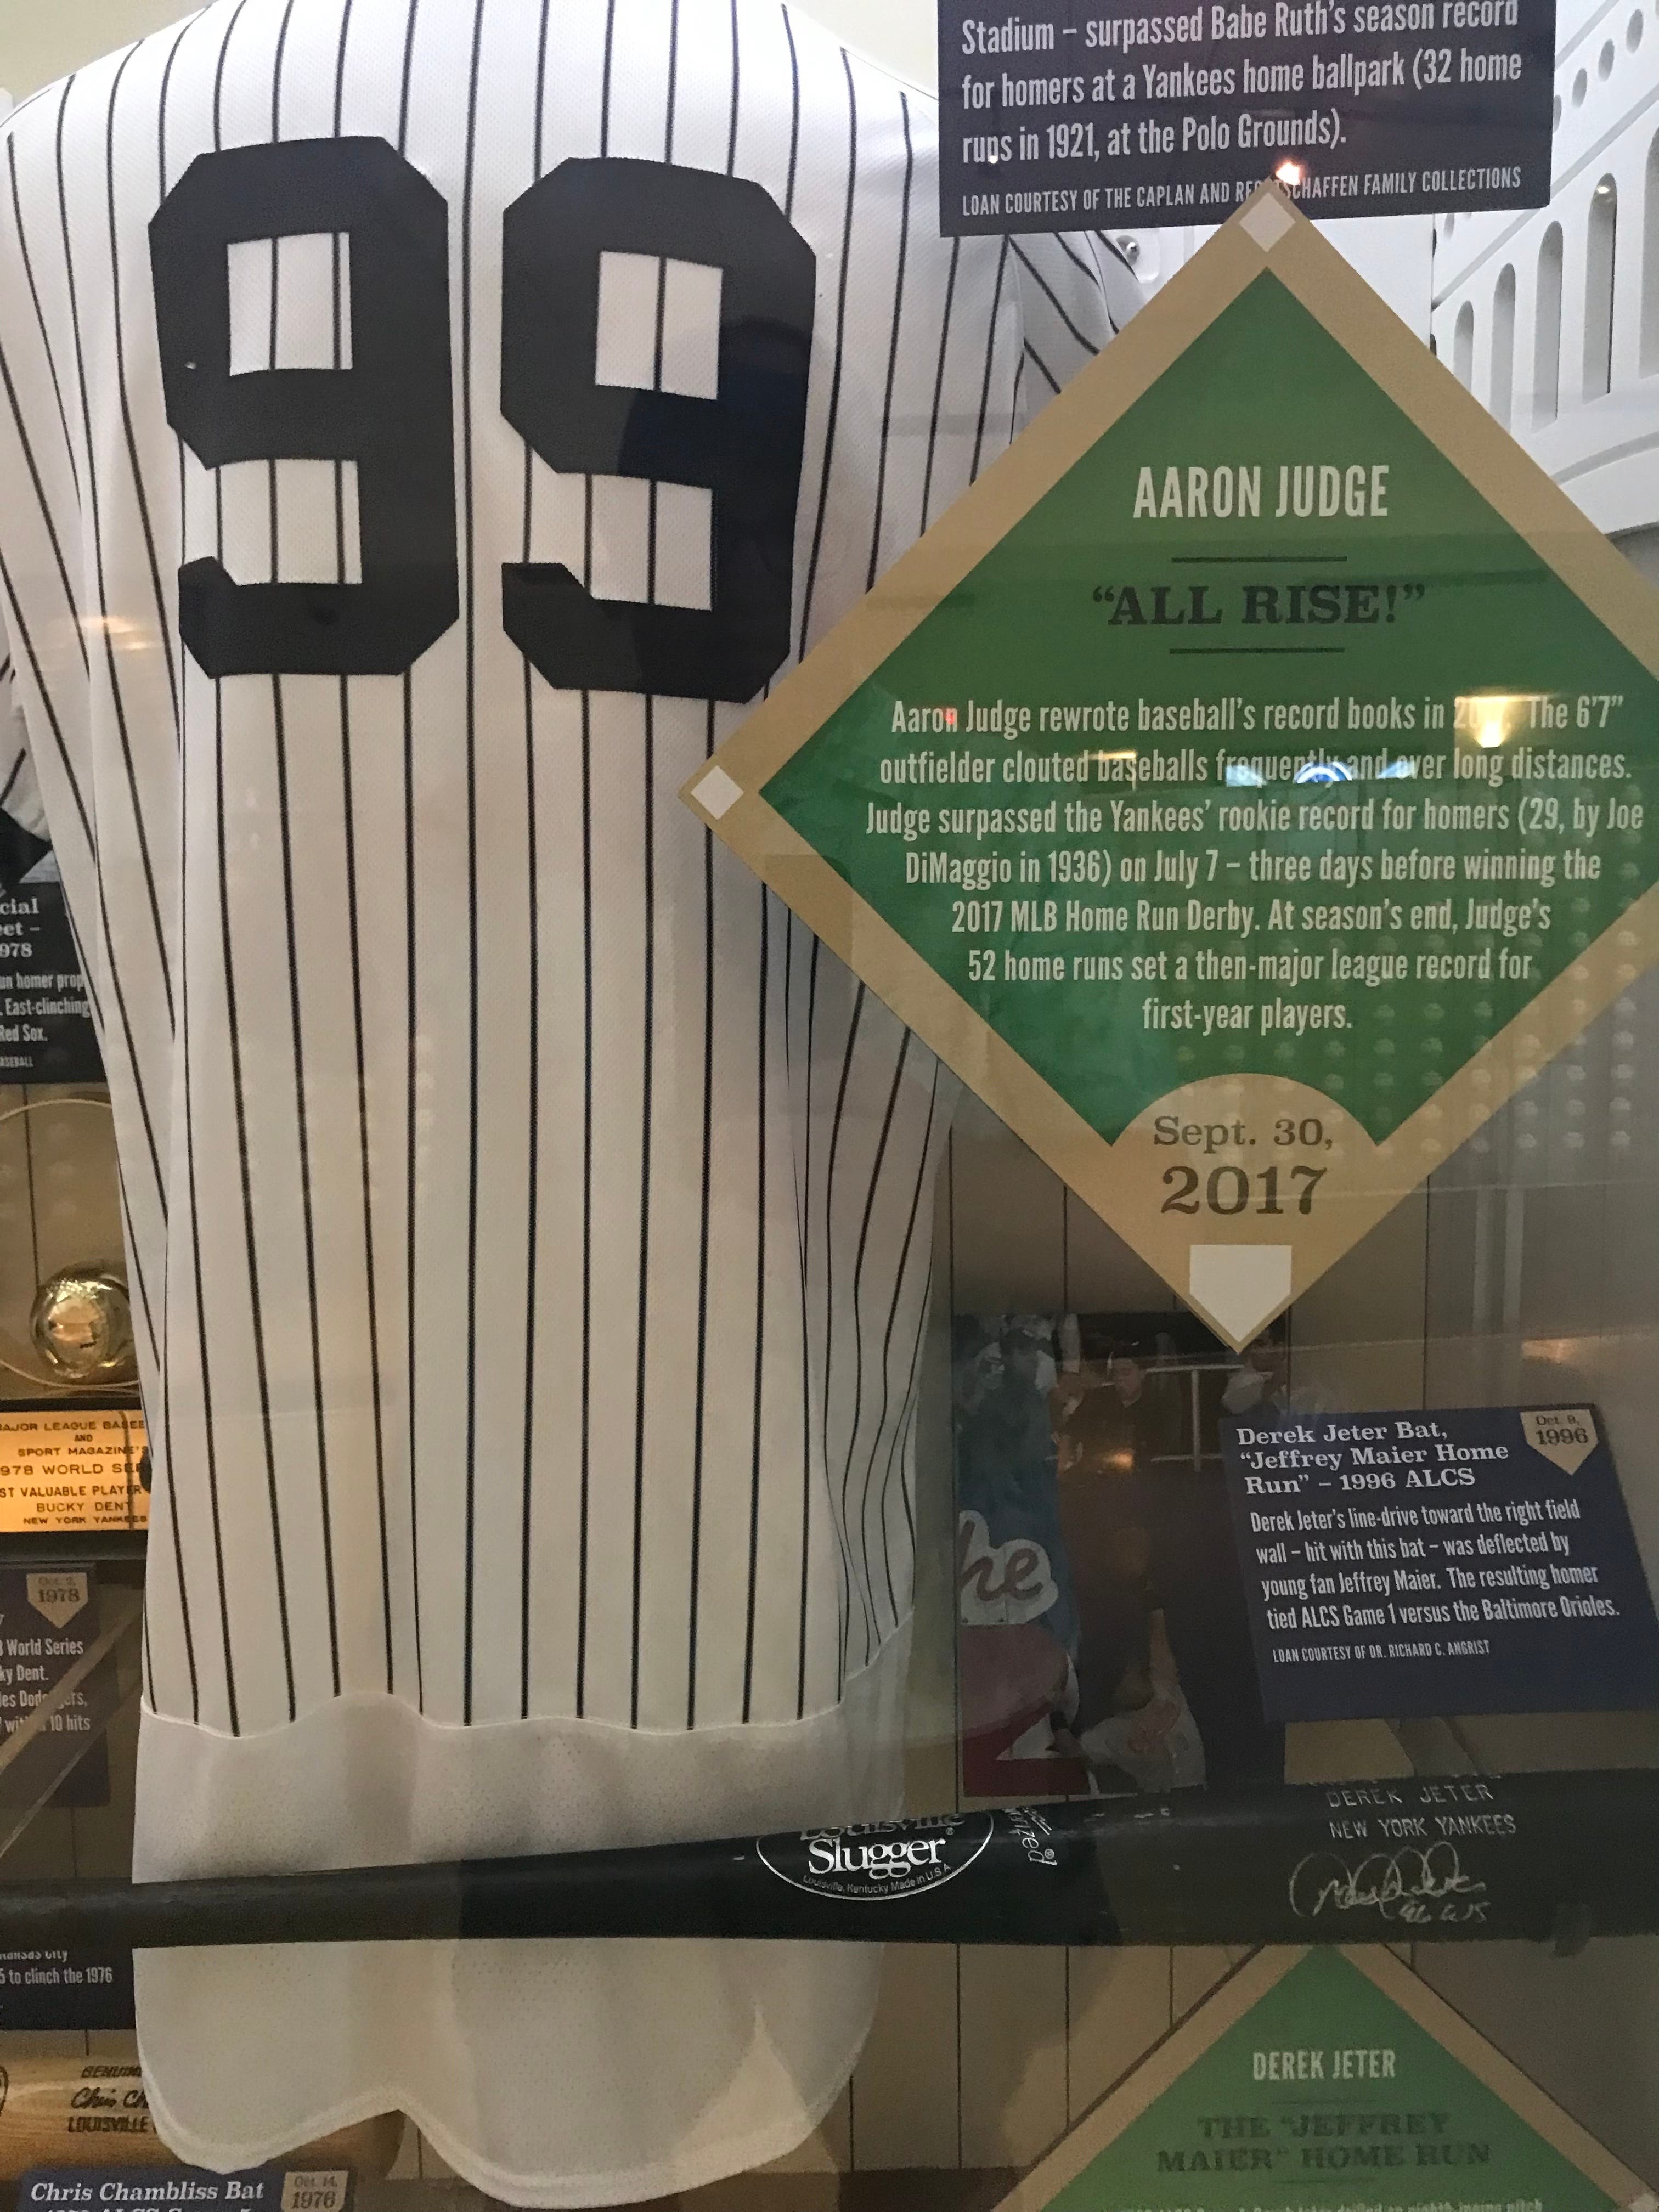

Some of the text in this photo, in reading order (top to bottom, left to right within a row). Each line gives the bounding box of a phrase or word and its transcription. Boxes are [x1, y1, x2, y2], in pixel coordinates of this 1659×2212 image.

[962, 18, 1054, 54] Stadium
[1086, 7, 1203, 54] surpassed
[1211, 4, 1266, 40] Babe
[1353, 1, 1434, 34] season
[1443, 0, 1518, 29] record
[963, 108, 1346, 163] runs in 1921, at the Polo Grounds).
[963, 194, 1000, 216] LOAN
[1005, 189, 1077, 214] COURTESY
[1083, 189, 1100, 210] OF
[1105, 187, 1131, 208] THE
[1137, 184, 1194, 207] CAPLAN
[1199, 181, 1229, 204] AND
[1364, 171, 1415, 195] FAMILY
[1421, 167, 1521, 192] COLLECTIONS
[147, 135, 817, 704] 99
[1133, 465, 1389, 518] AARON JUDGE
[1092, 583, 1425, 626] “ALL RISE!”
[891, 700, 958, 733] Aaron
[966, 699, 1031, 740] Judge
[1040, 700, 1129, 732] rewrote
[1264, 697, 1339, 730] record
[1348, 697, 1415, 730] books
[1424, 696, 1444, 729] in
[1529, 696, 1567, 729] The
[881, 751, 996, 784] outfielder
[1003, 751, 1088, 783] clouted
[1098, 748, 1207, 782] baseballs
[1347, 748, 1387, 780] and
[1397, 755, 1447, 781] over
[1454, 747, 1504, 787] long
[1511, 747, 1632, 779] distances.
[16, 972, 53, 989] homer
[1142, 997, 1353, 1036] first-year players.
[22, 1023, 48, 1042] Sox.
[1154, 1115, 1333, 1154] Sept. 30,
[1160, 1165, 1328, 1215] 2017
[44, 1421, 97, 1431] LEAGUE
[1236, 1421, 1447, 1446] Derek Jeter Bat,
[1536, 1427, 1589, 1446] 1996
[74, 1434, 93, 1442] AND
[18, 1447, 61, 1457] SPORT
[1350, 1446, 1427, 1465] Maier
[1434, 1444, 1509, 1462] Home
[42, 1463, 104, 1475] WORLD
[1339, 1472, 1396, 1491] 1996
[1405, 1467, 1475, 1488] ALCS
[20, 1484, 142, 1497] VALUABLE PLAYER
[36, 1501, 131, 1513] BUCKY DENT
[1250, 1511, 1295, 1532] Derek
[1348, 1505, 1419, 1528] line-drive
[1421, 1503, 1474, 1525] toward
[1477, 1502, 1502, 1522] the
[1505, 1500, 1544, 1526] right
[1545, 1498, 1581, 1520] field
[55, 1516, 87, 1524] YORK
[1256, 1531, 1570, 1564] wall hit with this bat was deflected by
[1261, 1564, 1599, 1601] young fan Jeffrey Maier. The resulting homer
[1267, 1595, 1620, 1629] tied ALCS Game 1 versus the Baltimore Orioles.
[6, 1638, 83, 1656] World Series
[1273, 1649, 1300, 1663] LOAN
[1302, 1646, 1351, 1662] COURTESY
[1354, 1646, 1365, 1659] OF
[1369, 1645, 1387, 1658] DR.
[1388, 1642, 1432, 1658] RICHARD
[1435, 1643, 1446, 1656] C.
[16, 1664, 49, 1681] Dent.
[66, 1714, 91, 1731] hits
[1326, 1784, 1494, 1807] DEREK JETER
[1329, 1813, 1516, 1839] NEW YORK YANKEES
[808, 1836, 946, 1880] Slugger
[847, 1883, 889, 1894] Kentucky
[890, 1878, 916, 1892] Made
[916, 1875, 926, 1886] in
[9, 1966, 113, 1984] to clinch the 1976
[1252, 2049, 1396, 2081] DEREK JETER
[67, 2116, 150, 2134] LOUISVILLE
[1197, 2116, 1271, 2138] THE
[1301, 2145, 1404, 2170] HOME
[1415, 2142, 1491, 2166] RUN
[30, 2180, 264, 2202] Chris Chambliss Bat
